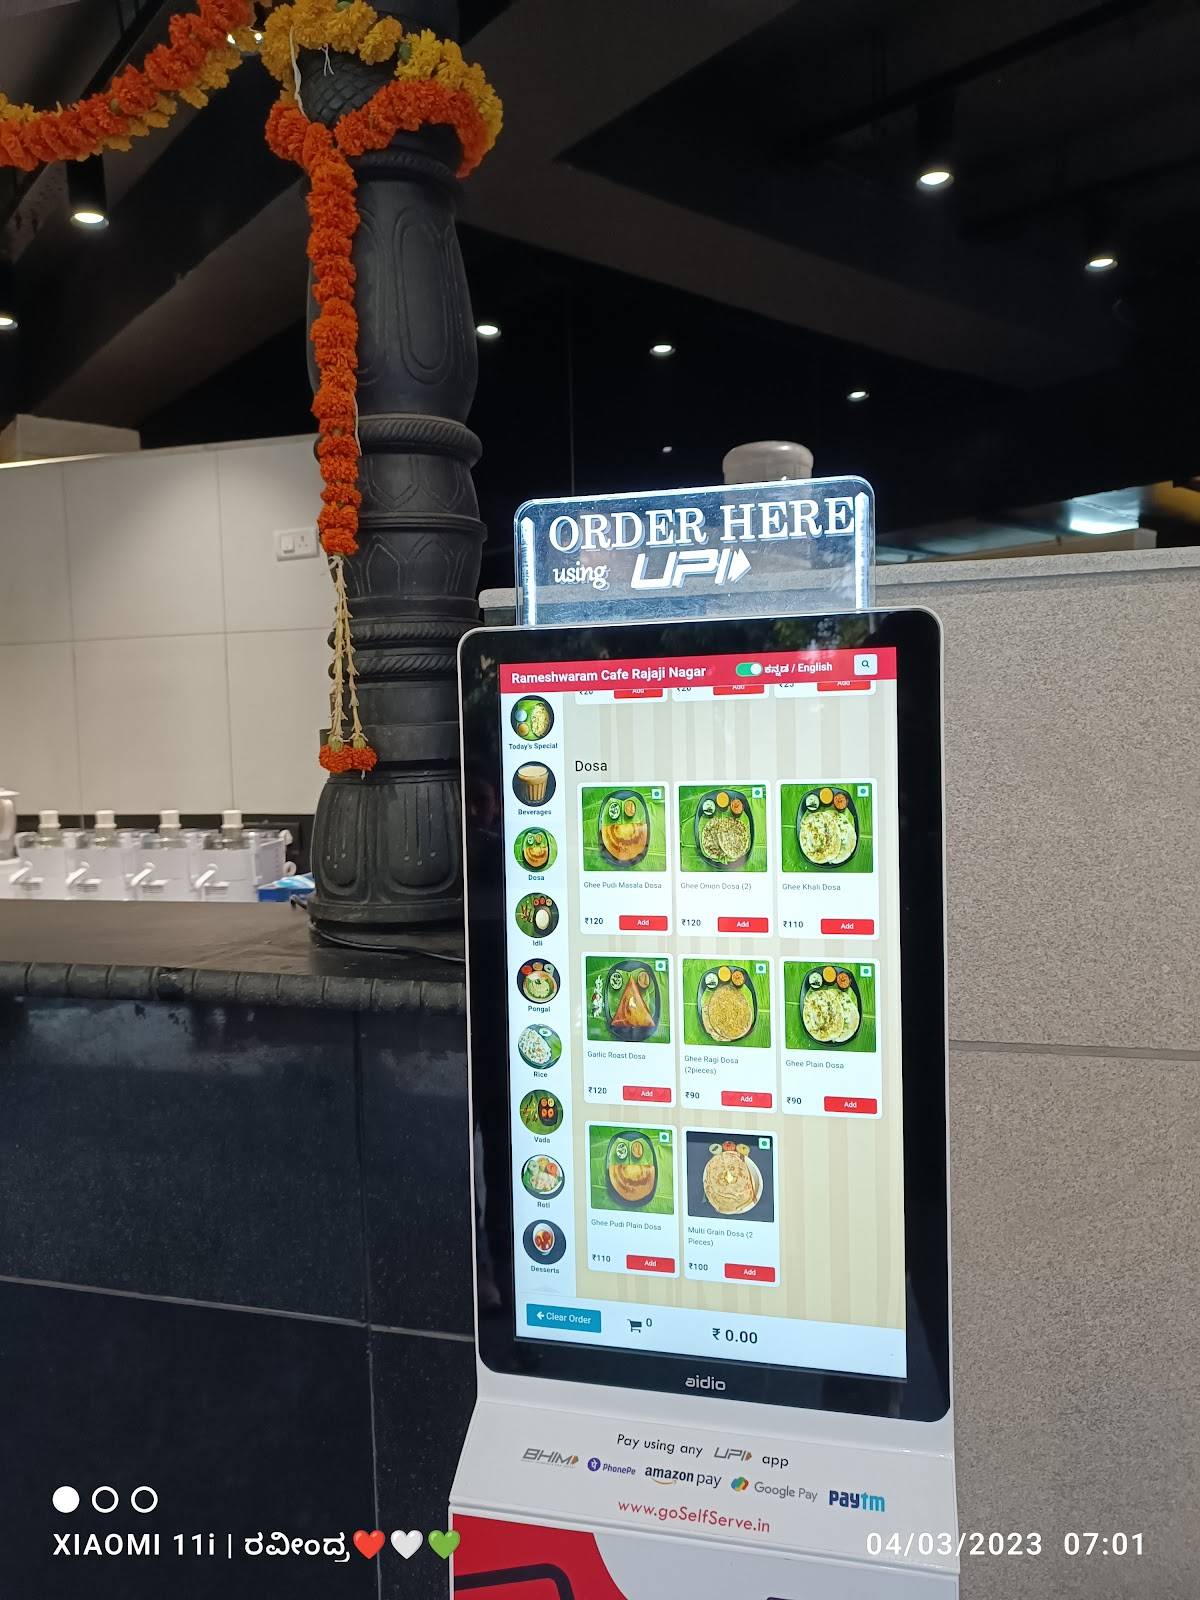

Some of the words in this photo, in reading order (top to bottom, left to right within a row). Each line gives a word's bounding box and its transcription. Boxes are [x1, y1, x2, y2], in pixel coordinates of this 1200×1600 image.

[548, 507, 708, 552] ORDER
[719, 496, 855, 541] HERE
[552, 560, 609, 589] using
[631, 548, 734, 589] UPI
[764, 663, 790, 677] ಕನ್ನಡ
[798, 661, 833, 674] English
[511, 671, 598, 684] Rameshwaram
[601, 668, 629, 680] Cafe
[632, 667, 666, 681] Rajaji
[669, 667, 706, 681] Nagar
[534, 742, 558, 750] Special
[575, 760, 608, 772] Dosa
[518, 808, 552, 817] Beverages
[583, 881, 601, 889] Ghee
[741, 882, 752, 891] (2)
[584, 917, 604, 925] ₹120
[528, 1005, 551, 1014] Pongal
[587, 1051, 606, 1059] Garlic
[608, 1051, 627, 1060] Roast
[628, 1052, 646, 1060] Dosa
[703, 1056, 719, 1064] Ragi
[684, 1066, 717, 1075] (2pieces)
[588, 1086, 608, 1095] ₹120
[685, 1091, 700, 1099] ₹90
[786, 1097, 802, 1105] ₹90
[534, 1136, 551, 1144] Vada
[537, 1201, 551, 1209] Roti
[591, 1218, 609, 1227] Ghee
[609, 1220, 625, 1228] Pudi
[626, 1221, 643, 1230] Plain
[644, 1222, 662, 1231] Dosa
[688, 1226, 706, 1236] Multi
[707, 1228, 726, 1237] Grain
[726, 1229, 745, 1238] Dosa
[688, 1238, 714, 1247] Pieces)
[592, 1253, 611, 1263] ₹110
[644, 1260, 657, 1268] Add
[688, 1262, 709, 1271] ₹100
[530, 1265, 560, 1274] Desserts
[743, 1268, 757, 1277] Add
[546, 1312, 567, 1322] Clear
[568, 1314, 592, 1325] Order
[645, 1318, 653, 1328] 0
[725, 1329, 758, 1344] 0.00
[685, 1375, 726, 1391] aidio
[617, 1433, 640, 1450] Pay
[644, 1438, 675, 1454] using
[679, 1444, 703, 1458] any
[714, 1447, 748, 1461] UPI
[762, 1455, 789, 1469] app
[523, 1448, 573, 1465] BHIM
[602, 1462, 636, 1476] PhonePe
[644, 1465, 694, 1483] amazon
[696, 1473, 722, 1488] pay
[754, 1481, 796, 1499] Google
[798, 1487, 818, 1503] Pay
[617, 1501, 771, 1533] www.goSelfServe.in
